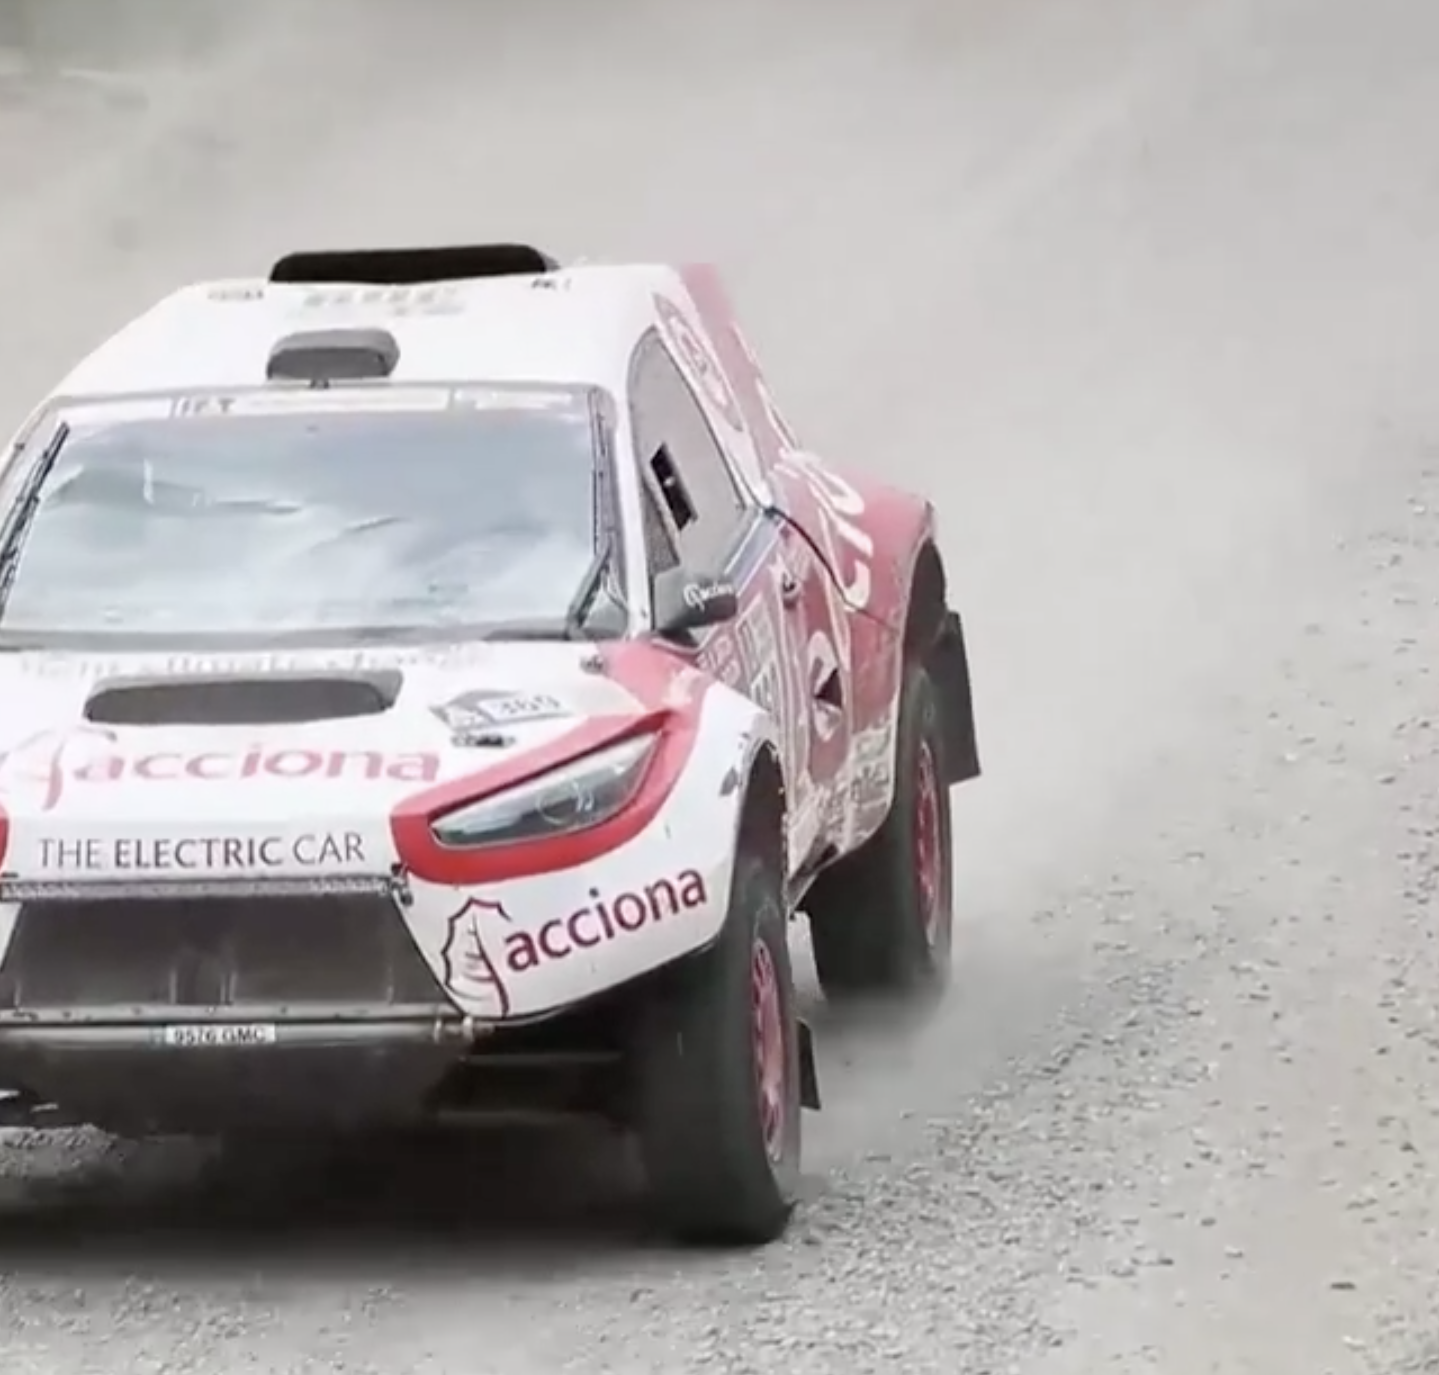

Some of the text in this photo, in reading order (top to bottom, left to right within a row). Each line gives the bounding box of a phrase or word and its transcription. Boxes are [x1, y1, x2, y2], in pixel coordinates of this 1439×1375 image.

[73, 743, 441, 782] acciona
[38, 832, 366, 869] THE ELECTRIC CAR
[504, 869, 708, 973] acciona
